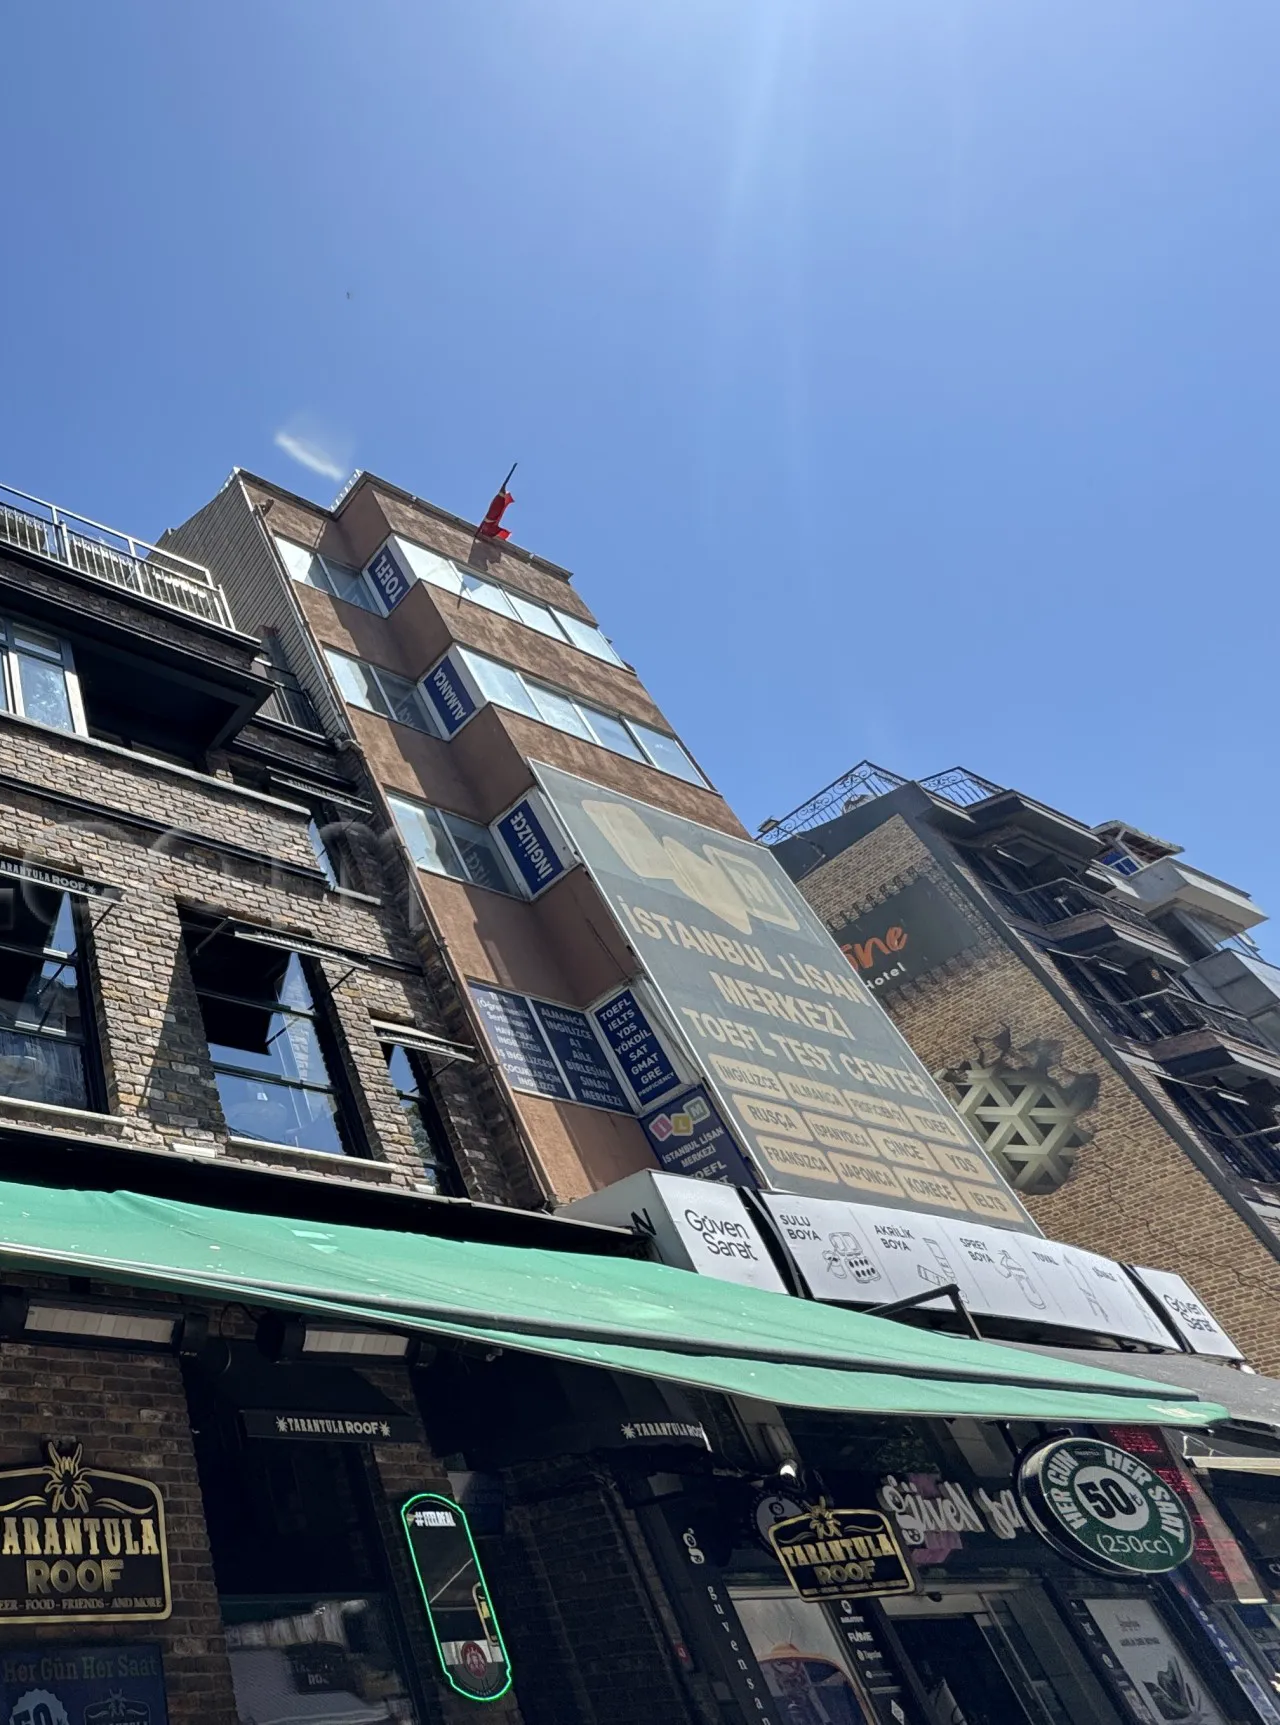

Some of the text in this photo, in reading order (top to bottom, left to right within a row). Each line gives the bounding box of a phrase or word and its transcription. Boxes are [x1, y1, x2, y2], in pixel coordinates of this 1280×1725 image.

[373, 555, 405, 605] TOEFL
[431, 667, 466, 721] ALMANCA
[509, 813, 555, 884] İNGİLİZCE
[51, 874, 86, 891] ROOF
[618, 896, 873, 1006] İSTANBUL LİSAN
[540, 1007, 586, 1027] ALMANCA
[599, 997, 632, 1022] TOEFL
[708, 970, 857, 1041] MERKEZİ
[545, 1019, 593, 1041] İNGİLİZCE
[607, 1010, 636, 1032] IELTS
[616, 1023, 638, 1040] YDS
[614, 1029, 652, 1055] YÖKDİL
[680, 1006, 778, 1058] TOEFL
[768, 1032, 841, 1075] TEST
[628, 1044, 649, 1062] SAT
[630, 1053, 659, 1075] GMAT
[638, 1071, 676, 1097] PROFICIENCY
[640, 1067, 663, 1085] GRE
[581, 1089, 625, 1107] MERKEZİ
[716, 1060, 781, 1092] İNGİLİZCE
[789, 1082, 844, 1107] ALMANCA
[915, 1114, 957, 1137] TOEFL
[746, 1104, 798, 1131] RUSÇA
[882, 1137, 925, 1161] ÇİNCE
[661, 1126, 725, 1164] İSTANBUL LİSAN
[680, 1144, 717, 1168] MERKEZİ
[763, 1145, 831, 1173] FRANSIZCA
[838, 1162, 898, 1188] JAPONCA
[684, 1208, 750, 1240] Güven
[779, 1214, 811, 1227] SULU
[873, 1224, 916, 1240] AKRİLİK
[701, 1231, 759, 1261] Sanat
[788, 1228, 822, 1242] BOYA
[880, 1238, 912, 1251] BOYA
[959, 1237, 989, 1251] SPREY
[967, 1250, 995, 1264] BOYA
[1163, 1293, 1206, 1317] Güven
[1179, 1310, 1218, 1334] Sanat
[287, 1417, 379, 1436] TARANTULA ROOF
[633, 1423, 688, 1437] TARANTULA
[1049, 1488, 1088, 1530] HER
[1104, 1448, 1153, 1486] HER
[1148, 1485, 1185, 1543] SAAT
[1076, 1478, 1137, 1519] 50
[780, 1533, 897, 1567] TARANTULA
[1097, 1533, 1174, 1557] (250cc)
[25, 1558, 125, 1595] ROOF
[812, 1559, 876, 1586] ROOF
[25, 1598, 55, 1611] FOOD
[61, 1598, 105, 1611] FRIENDS
[118, 1654, 159, 1678] Saat
